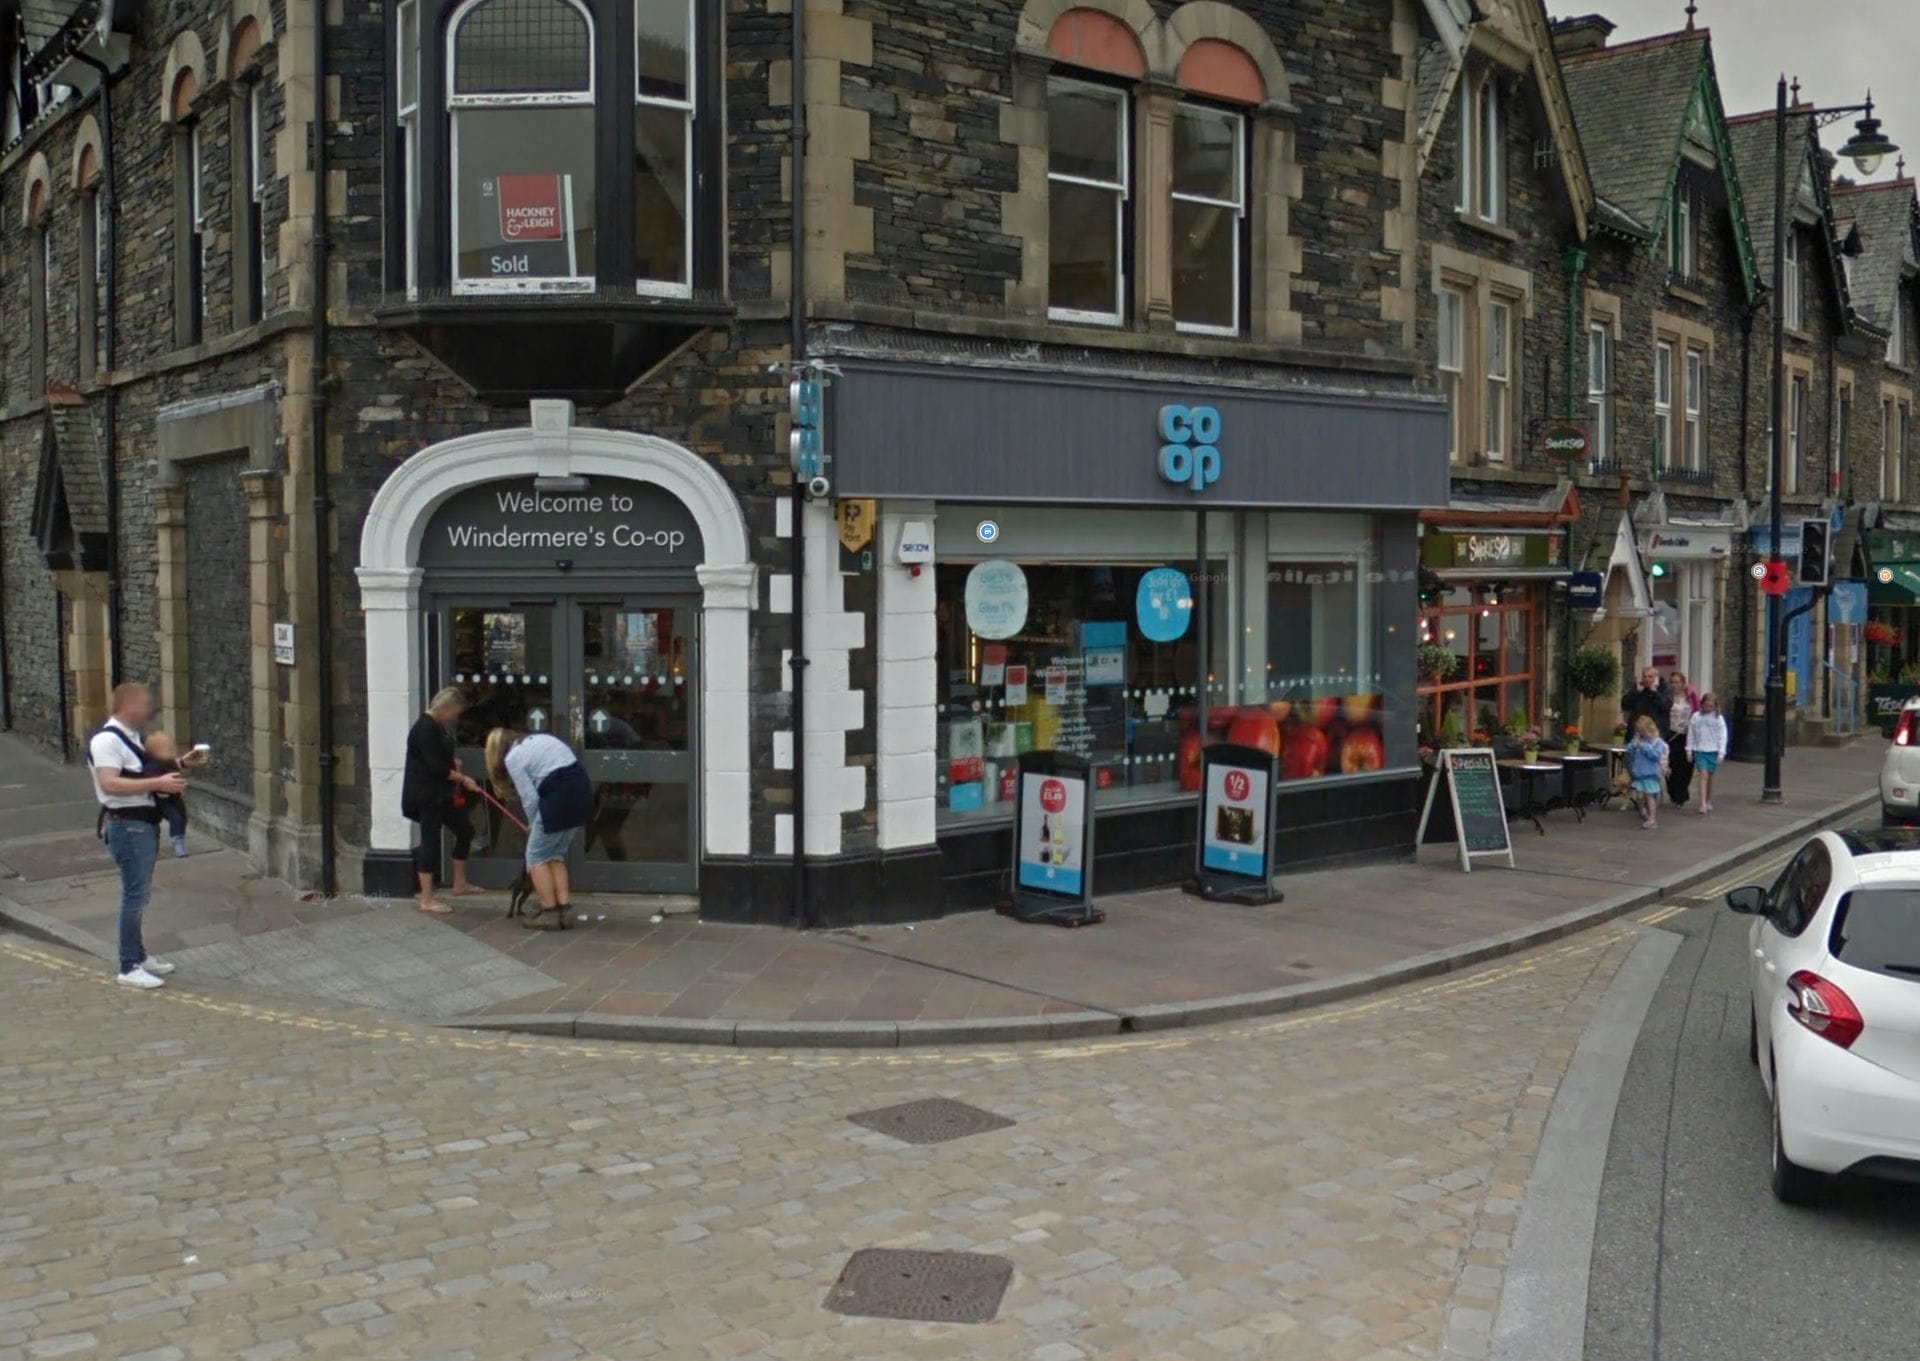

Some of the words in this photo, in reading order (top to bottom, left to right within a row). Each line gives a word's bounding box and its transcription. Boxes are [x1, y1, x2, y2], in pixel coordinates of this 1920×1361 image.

[506, 207, 556, 218] HACKNEY
[525, 218, 554, 228] LEIGH
[490, 255, 529, 273] Sold
[496, 491, 602, 513] Welcome
[610, 493, 634, 513] to
[447, 525, 606, 548] Windermere's
[612, 525, 685, 554] Co-op
